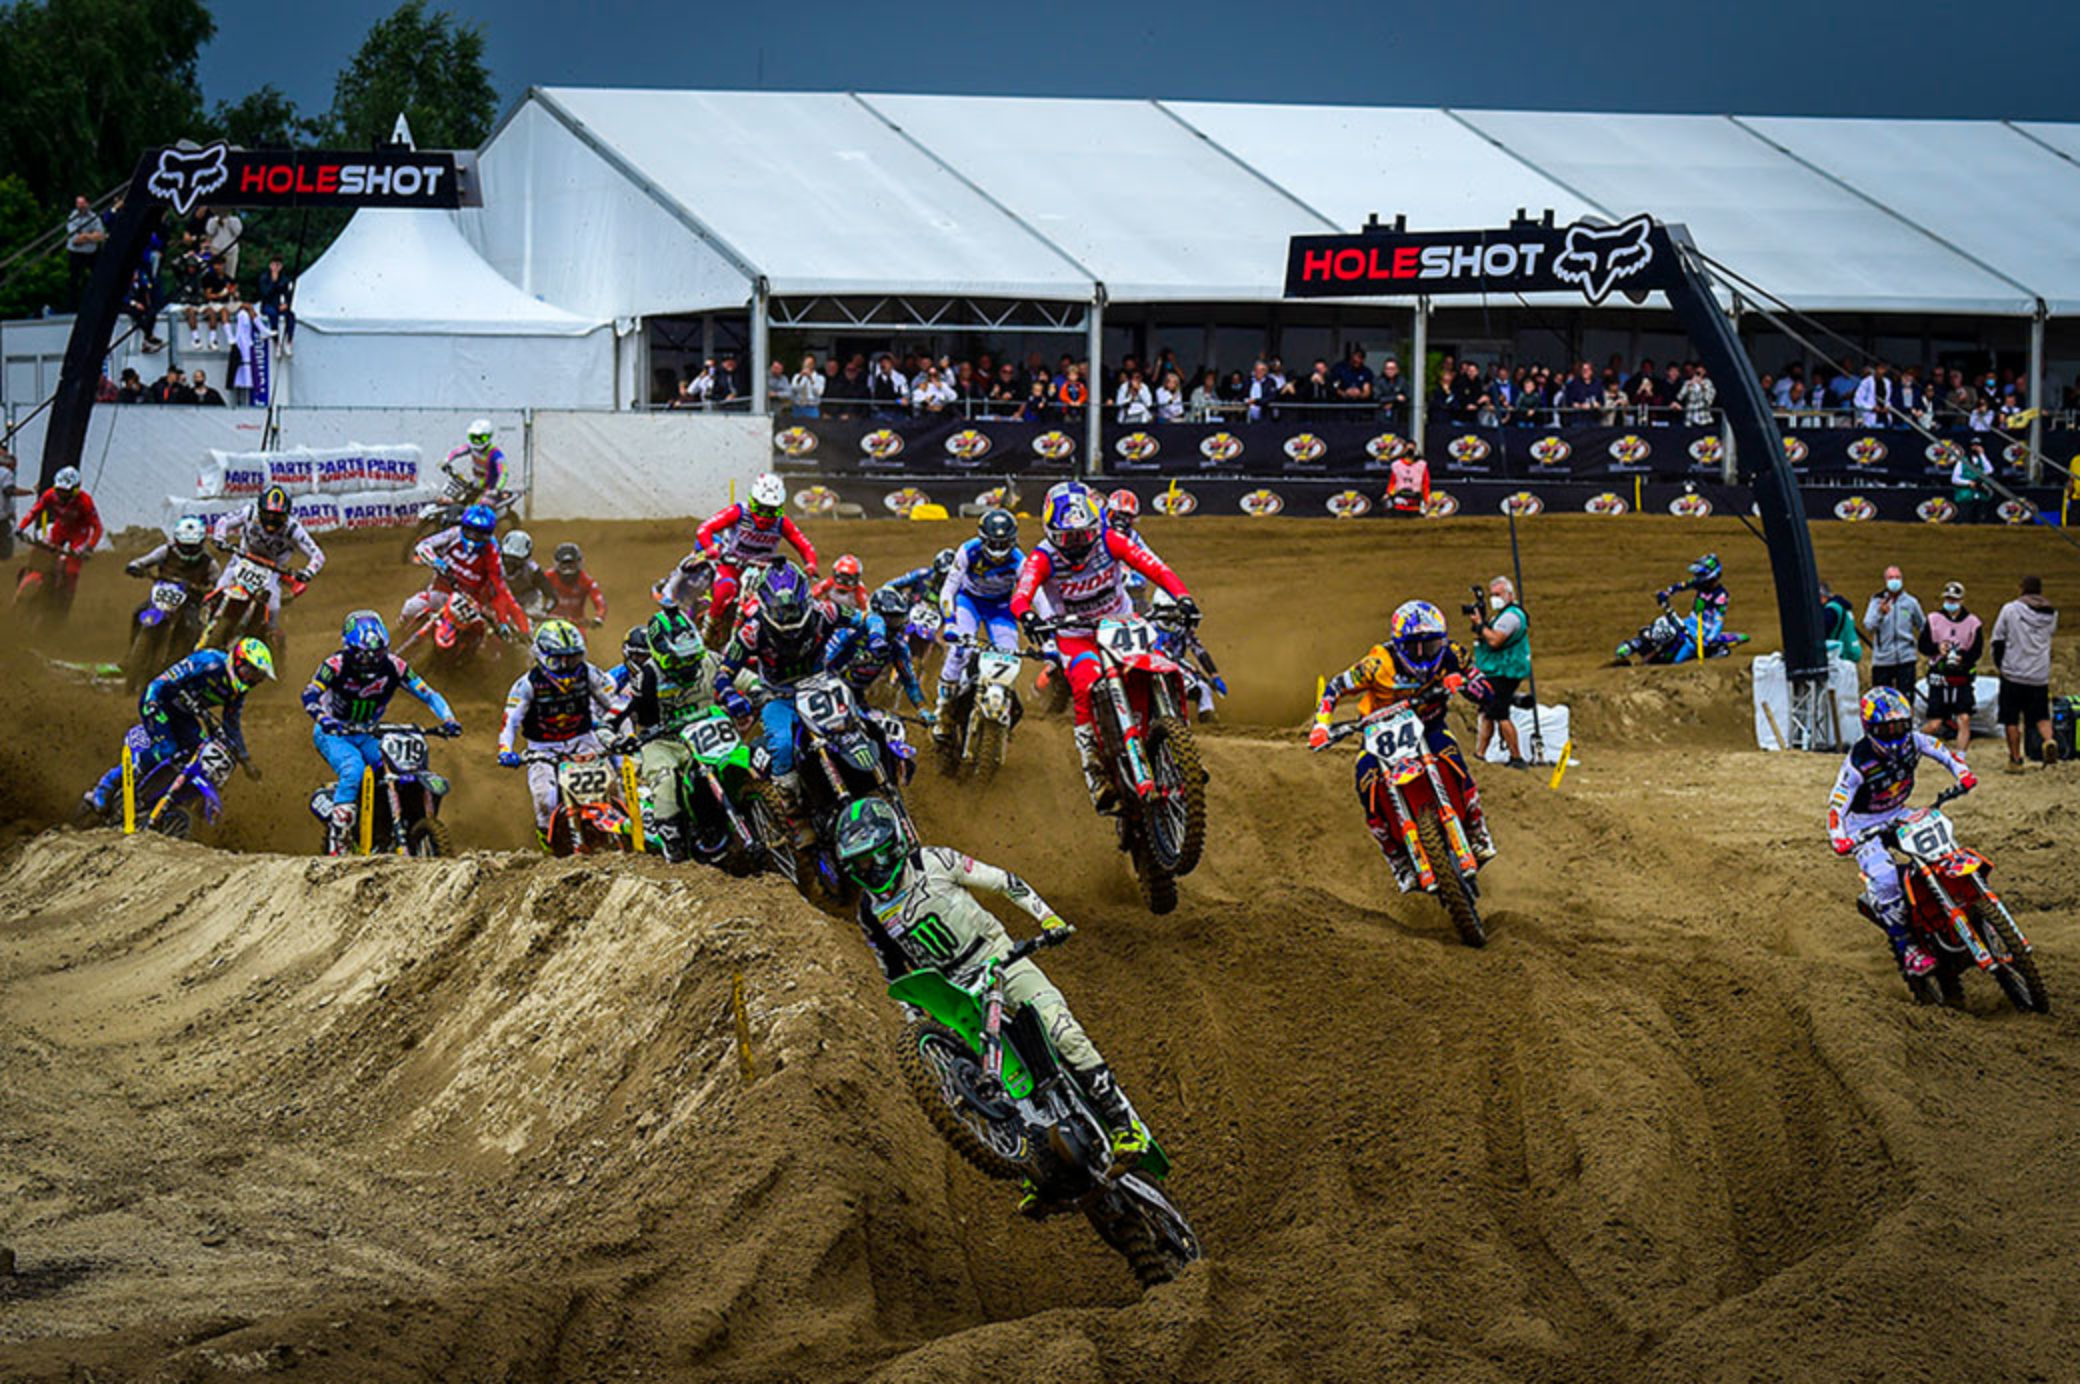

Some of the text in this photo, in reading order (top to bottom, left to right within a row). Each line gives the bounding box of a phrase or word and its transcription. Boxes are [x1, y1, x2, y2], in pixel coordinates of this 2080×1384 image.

[241, 165, 444, 195] HOLESHOT
[1302, 243, 1544, 281] HOLESHOT
[367, 459, 416, 475] PARTS
[344, 504, 392, 519] PARTS
[237, 567, 267, 587] 105
[1059, 566, 1115, 597] THOR
[913, 607, 940, 624] 32
[1111, 626, 1151, 652] 41
[992, 662, 1012, 680] 7
[808, 686, 847, 721] 91
[690, 720, 736, 753] 128
[1376, 721, 1418, 758] 84
[388, 739, 425, 762] 919
[568, 770, 608, 794] 222
[1911, 821, 1950, 854] 61
